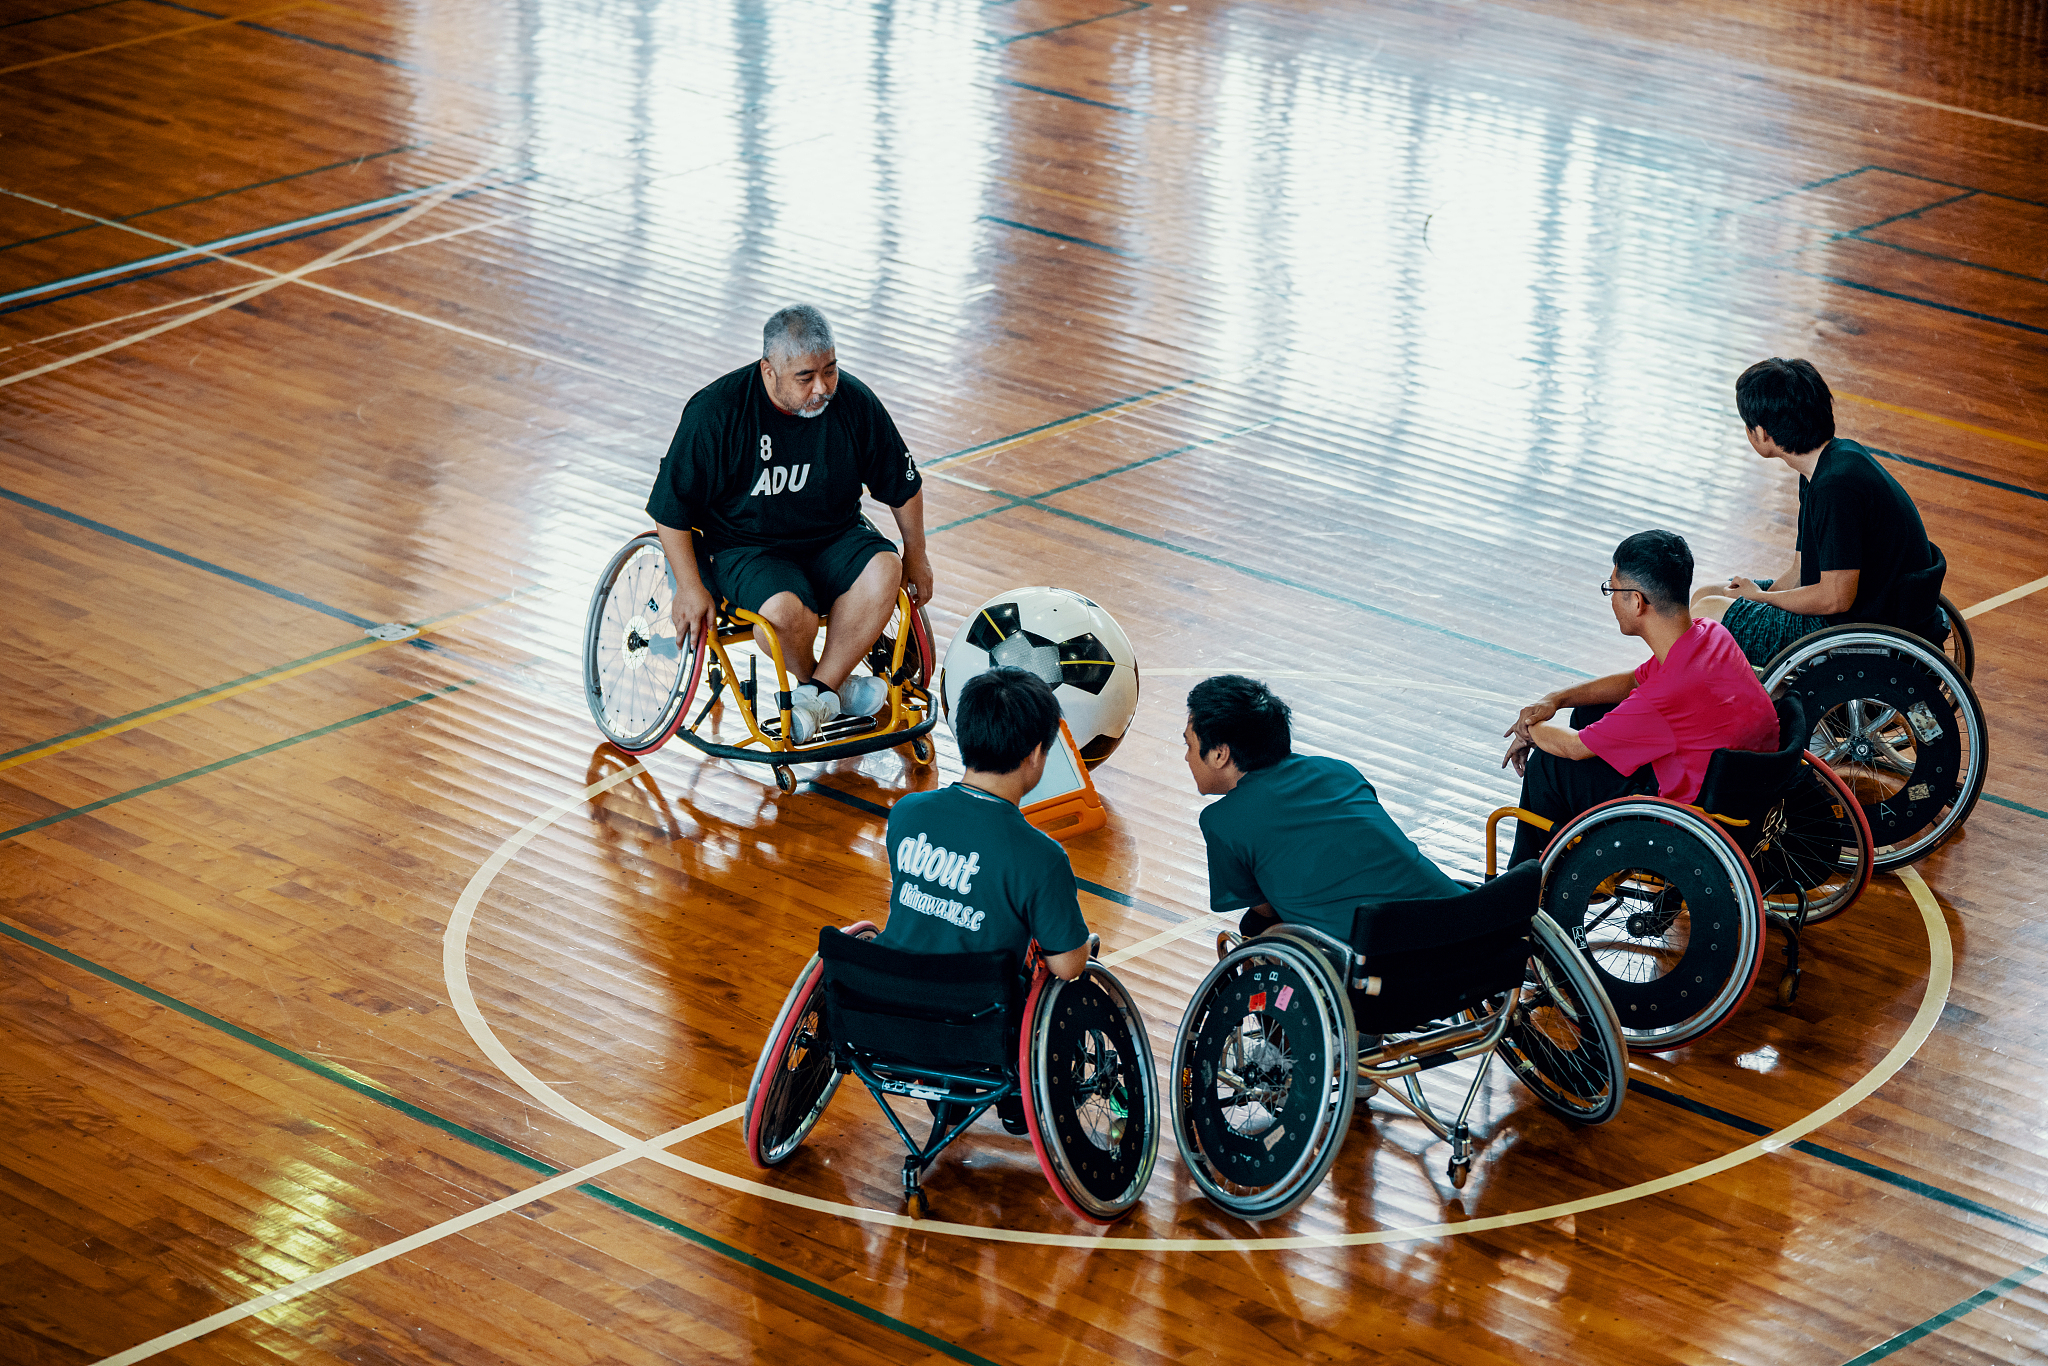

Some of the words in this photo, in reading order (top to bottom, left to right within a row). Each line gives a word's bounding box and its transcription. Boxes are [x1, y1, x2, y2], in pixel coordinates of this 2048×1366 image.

[760, 434, 772, 461] 8
[750, 463, 811, 496] ADU
[897, 832, 980, 895] about
